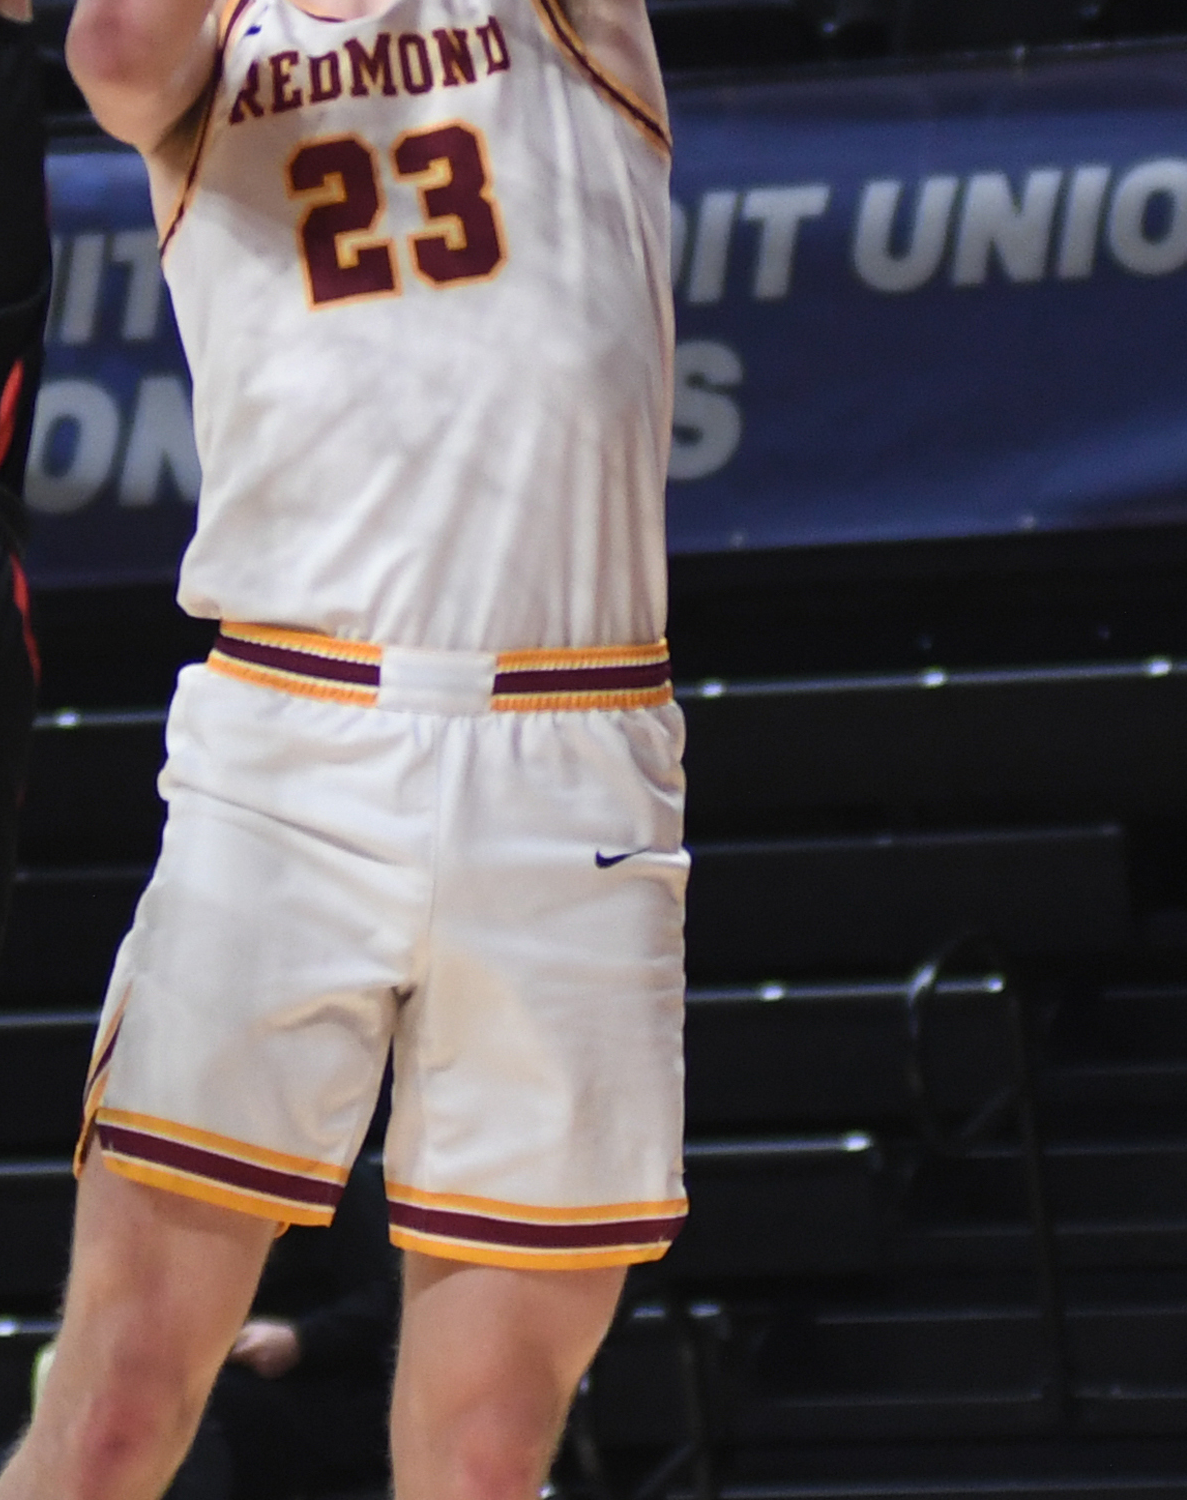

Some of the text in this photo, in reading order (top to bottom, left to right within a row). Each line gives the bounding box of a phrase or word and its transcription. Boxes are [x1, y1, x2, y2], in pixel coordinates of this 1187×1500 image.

[228, 14, 512, 116] REDMOND
[282, 118, 509, 312] 23
[854, 157, 1187, 293] UNIO
